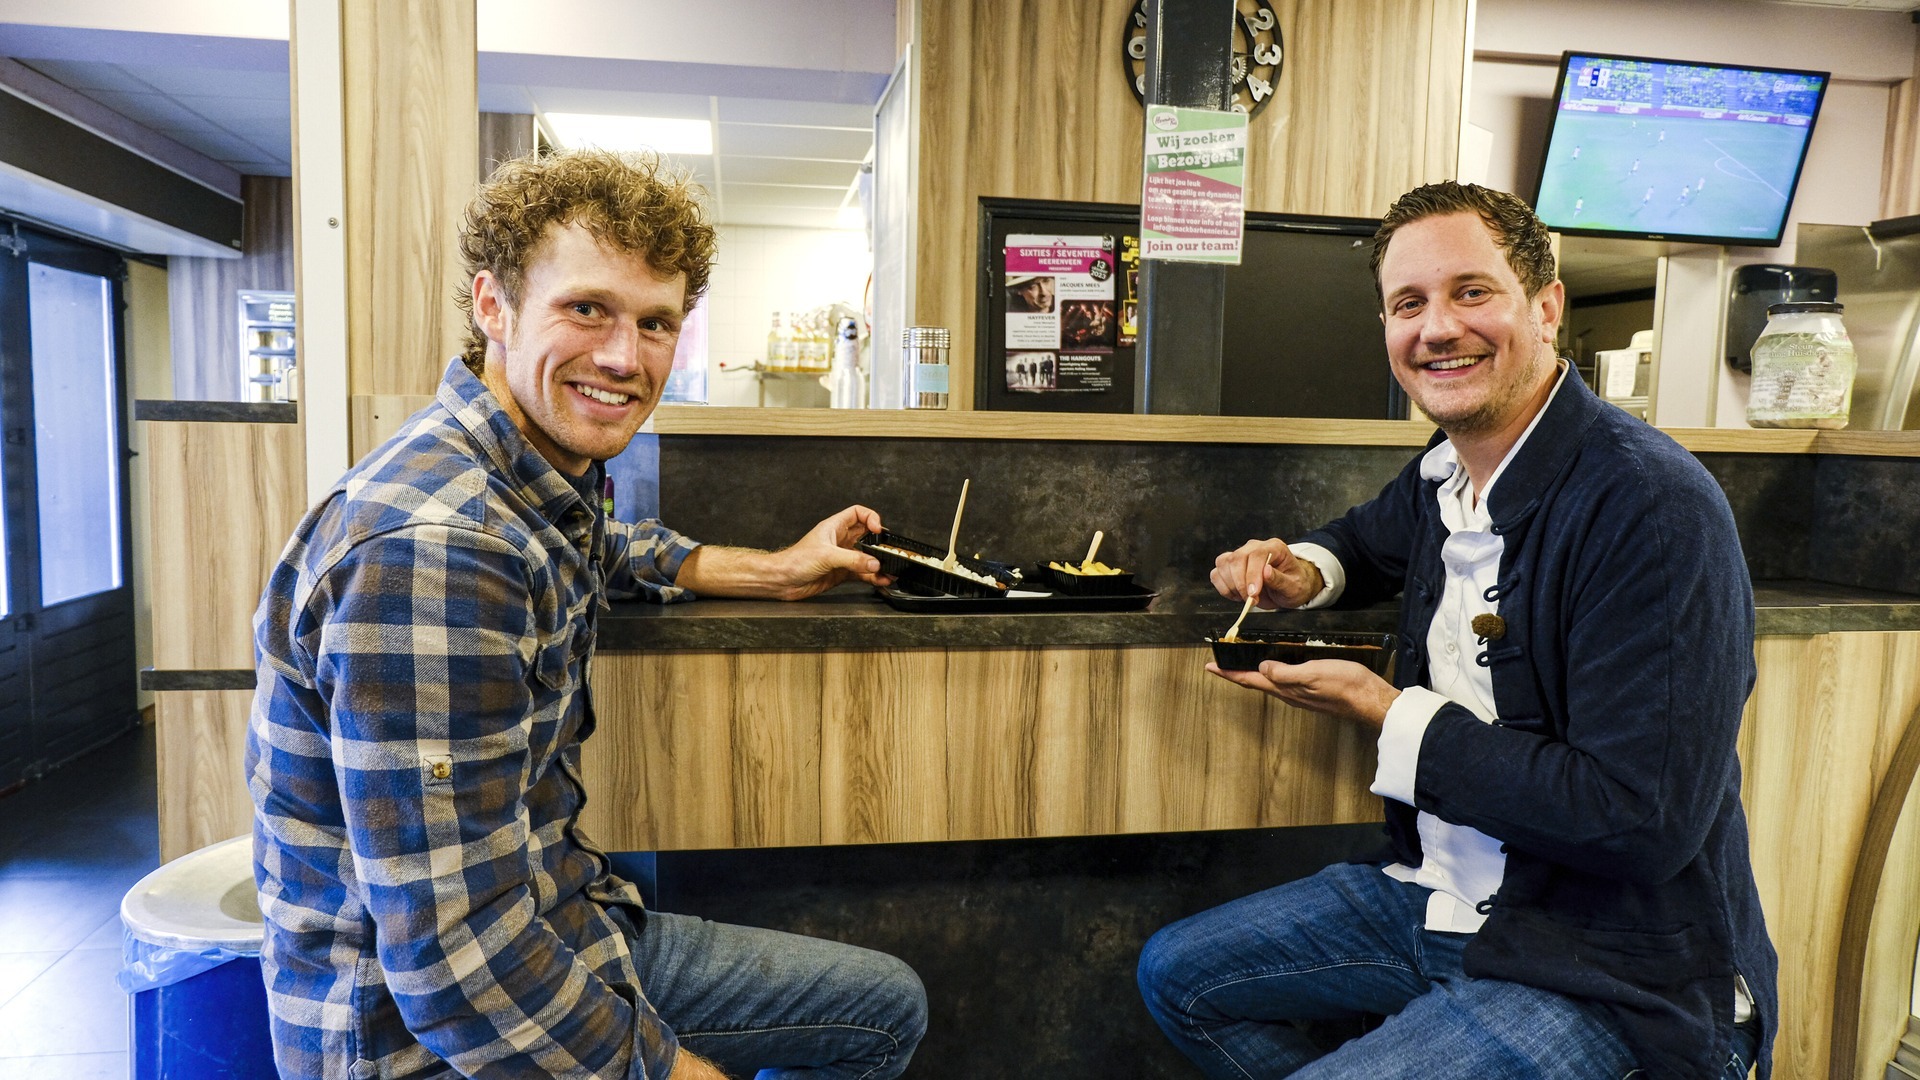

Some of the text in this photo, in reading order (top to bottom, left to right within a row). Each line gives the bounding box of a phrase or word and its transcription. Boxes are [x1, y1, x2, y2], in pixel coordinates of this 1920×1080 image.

[1157, 132, 1236, 149] Wij zoeken
[1157, 149, 1239, 169] Bezorgers!
[1149, 177, 1201, 187] Lijkt het jou leuk
[1172, 189, 1197, 198] gezellig
[1206, 191, 1240, 200] dynamisch
[1147, 215, 1163, 223] Loop
[1164, 216, 1185, 224] binnen
[1147, 240, 1173, 253] Join
[1176, 241, 1198, 251] our
[1201, 240, 1239, 251] team!
[1020, 248, 1051, 257] SIXTIES
[1056, 249, 1101, 258] SEVENTIES
[1097, 260, 1106, 269] 13
[1091, 269, 1107, 280] 2023
